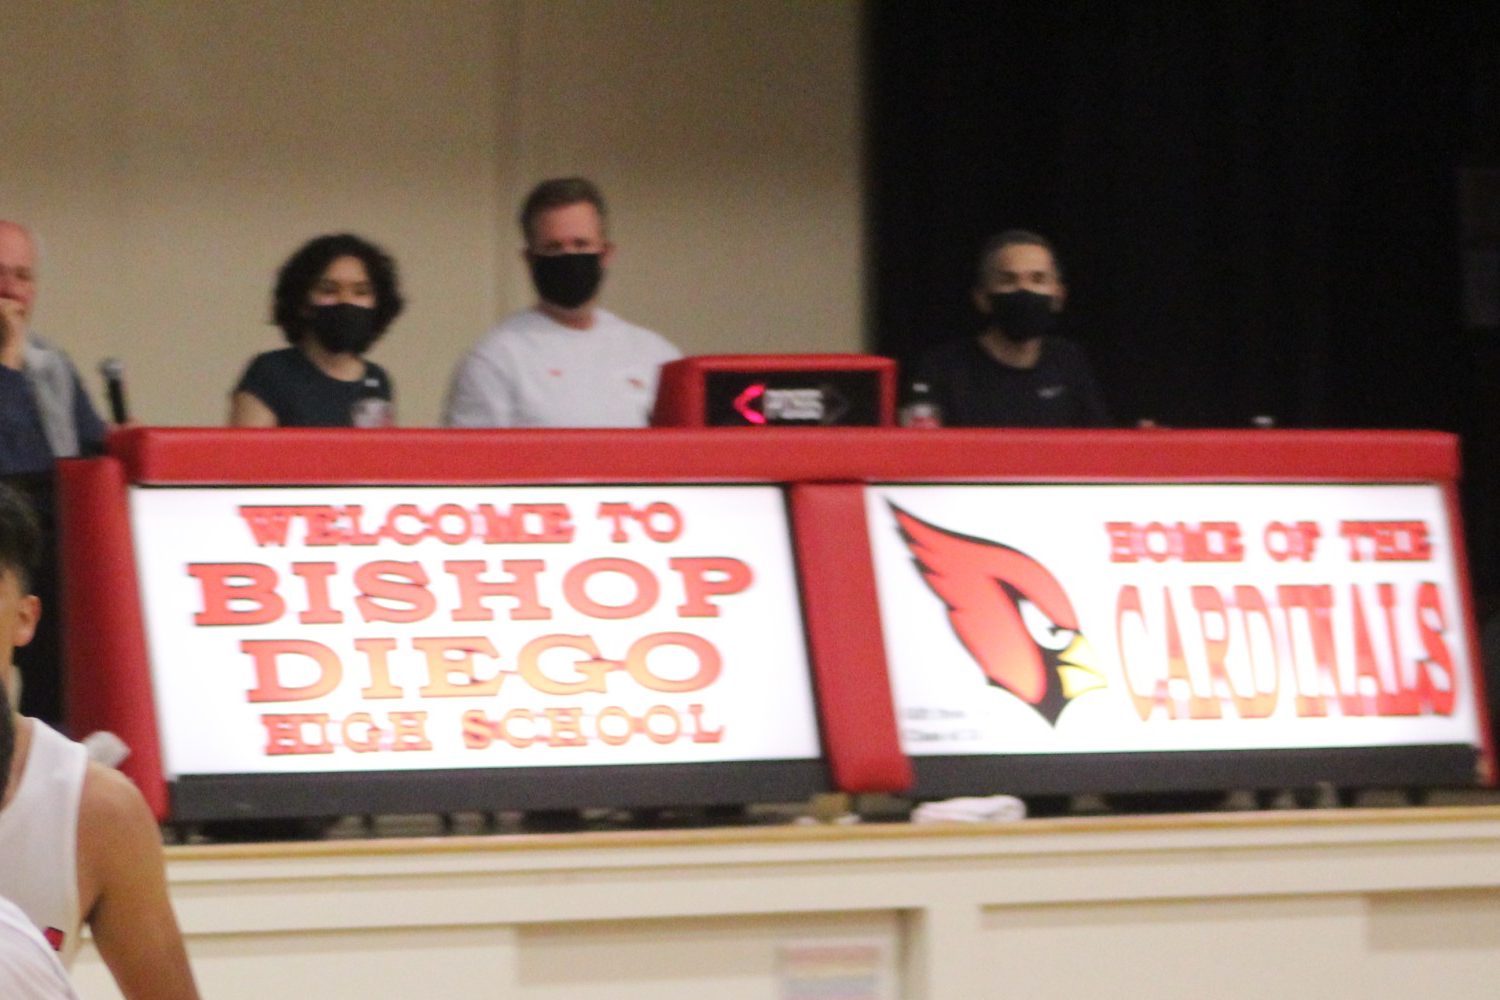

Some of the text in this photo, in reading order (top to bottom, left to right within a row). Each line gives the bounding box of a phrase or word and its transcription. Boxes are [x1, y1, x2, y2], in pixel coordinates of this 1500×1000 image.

[238, 502, 684, 547] WELCOME TO
[1105, 520, 1433, 563] HOME OF THE
[187, 557, 754, 627] BISHOP
[240, 631, 722, 704] DIEGO
[1115, 581, 1457, 722] CARDINALS
[261, 704, 724, 756] HIGH SCHOOL
